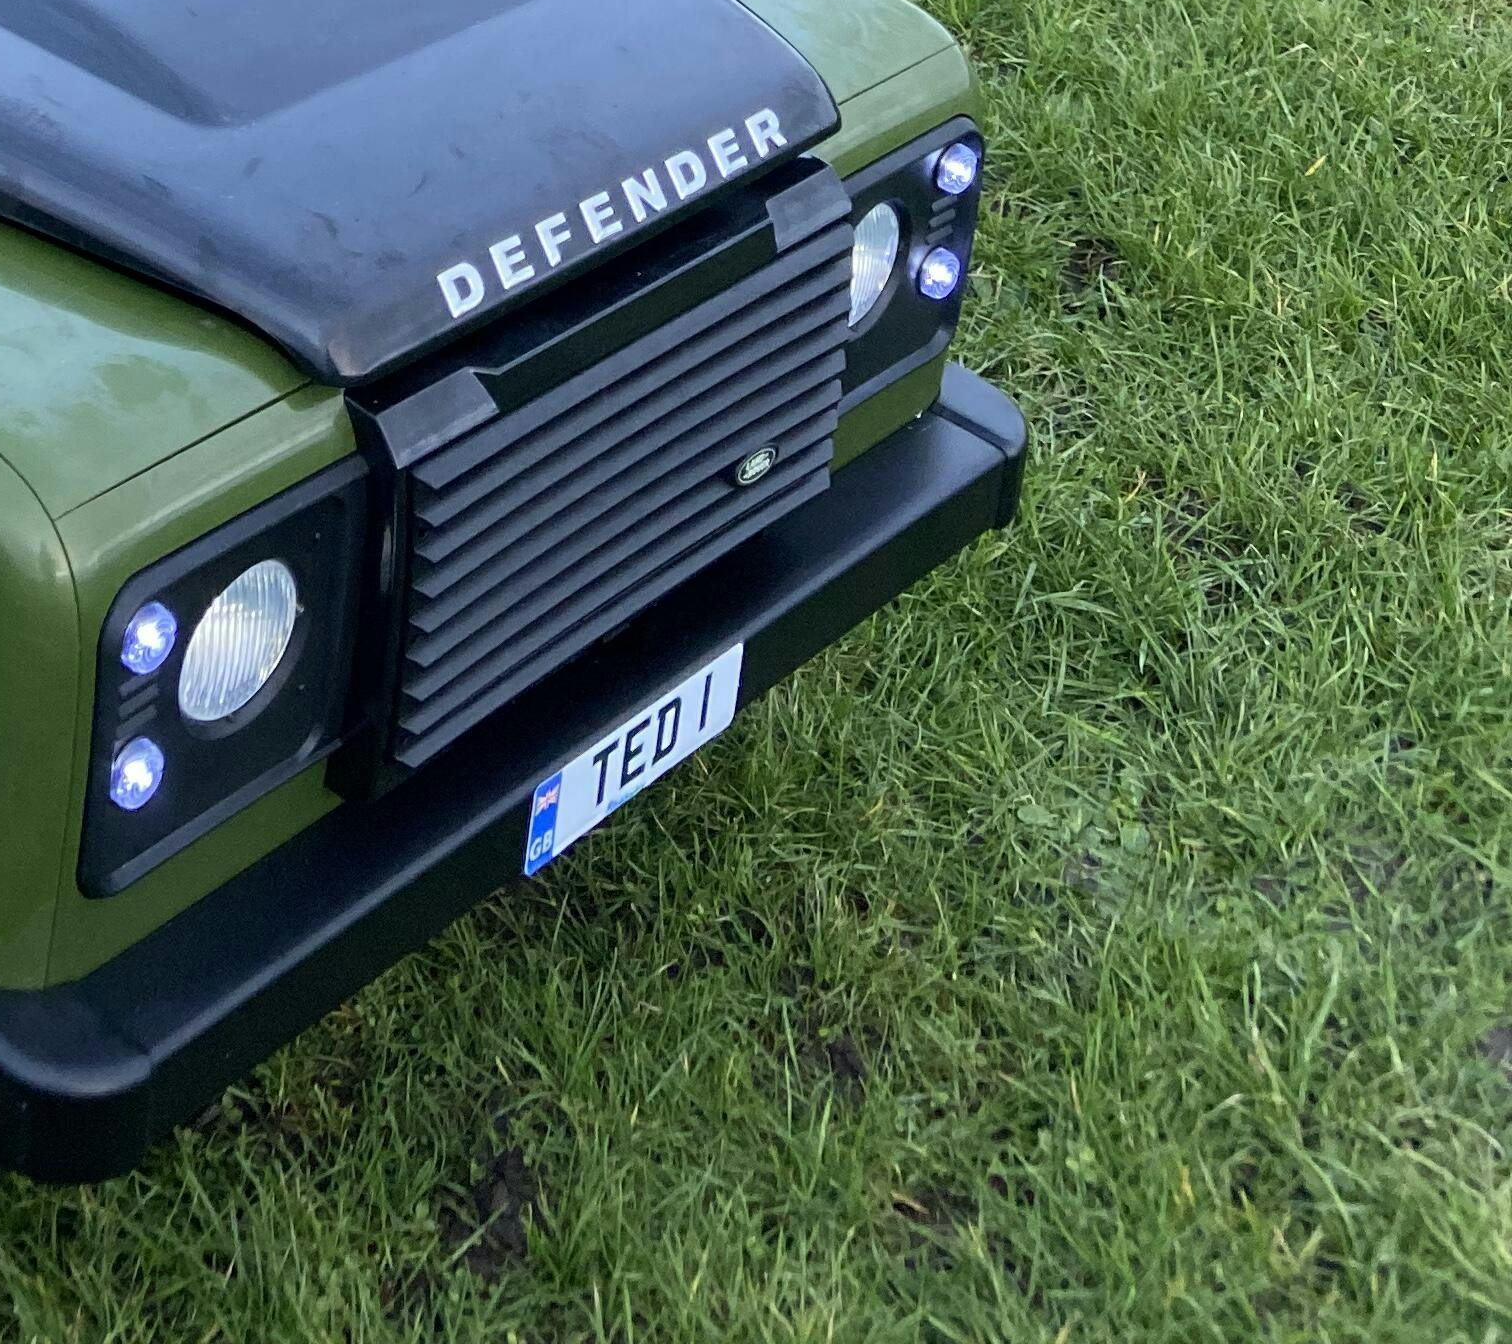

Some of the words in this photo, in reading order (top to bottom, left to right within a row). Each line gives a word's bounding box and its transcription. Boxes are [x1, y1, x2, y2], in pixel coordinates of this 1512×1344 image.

[436, 108, 788, 318] DEFENDER
[593, 696, 682, 807] TED
[530, 830, 552, 861] GB
